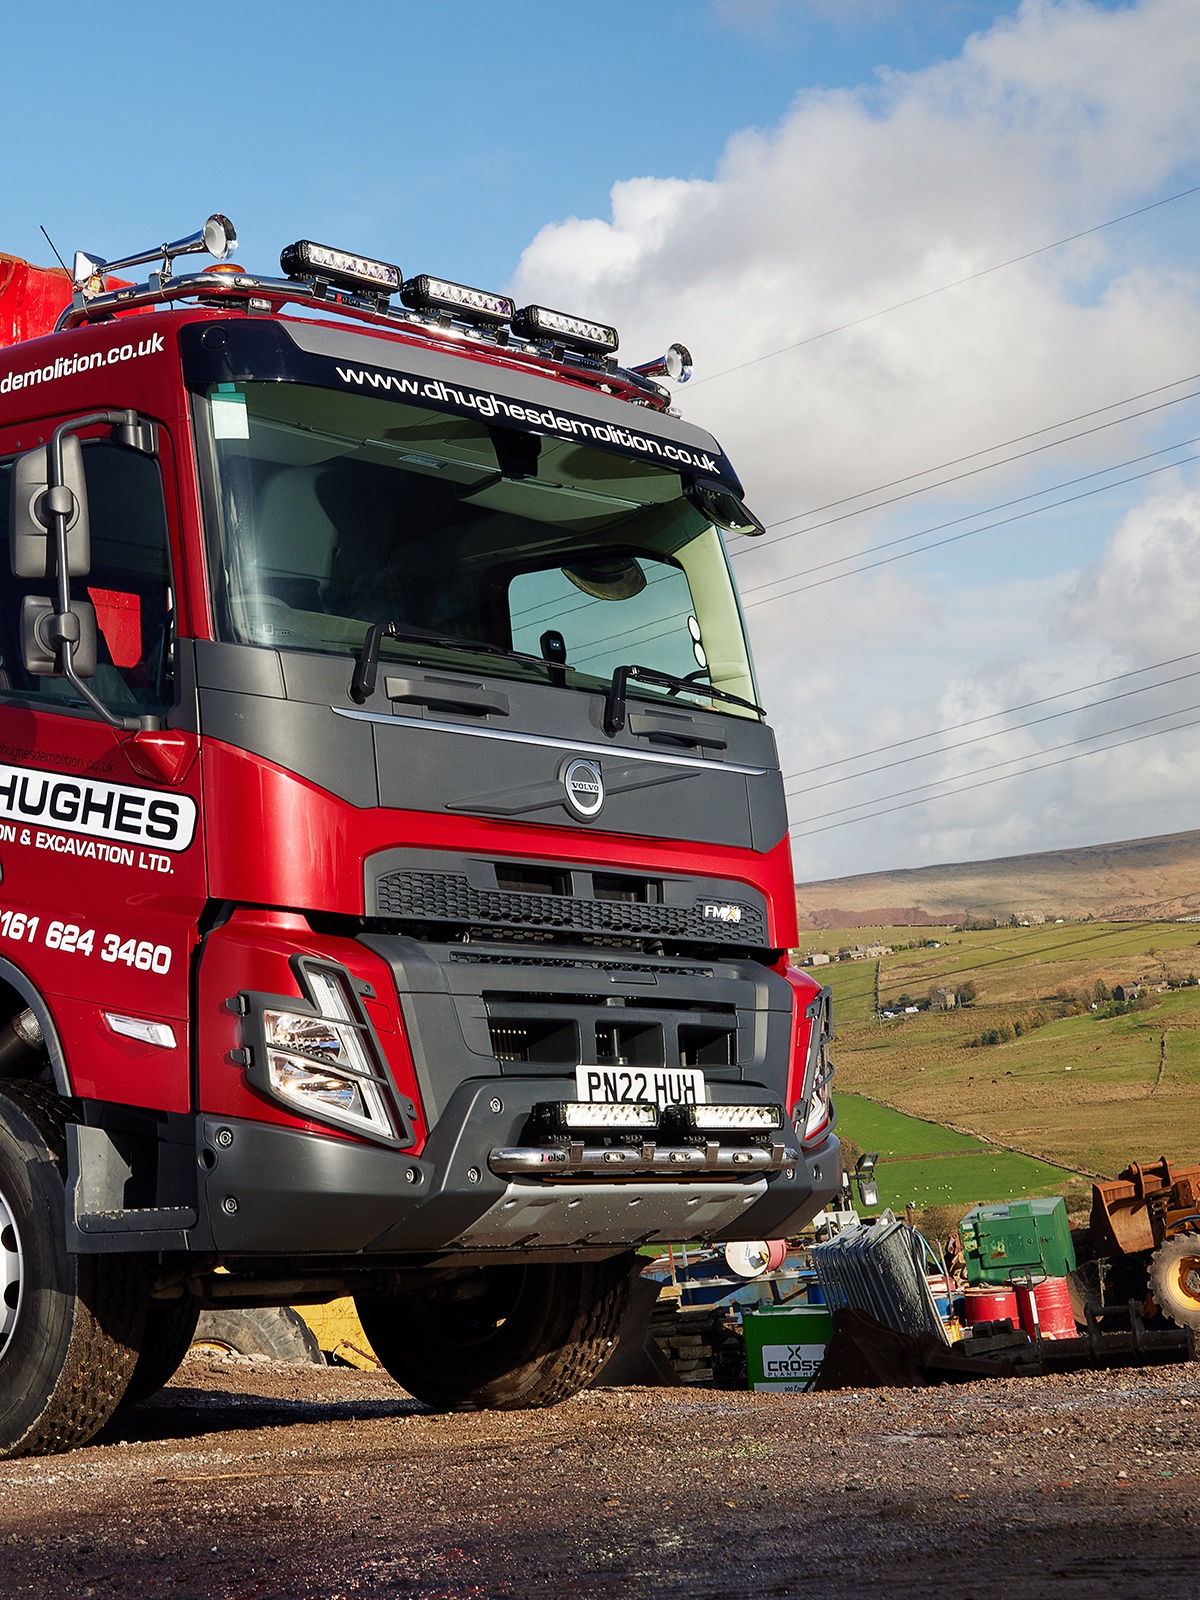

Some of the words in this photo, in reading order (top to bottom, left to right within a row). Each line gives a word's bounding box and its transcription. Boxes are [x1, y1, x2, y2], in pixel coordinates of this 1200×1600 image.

[335, 366, 721, 475] www.dhughesdemolition.co.uk
[572, 782, 599, 792] VOLVO
[20, 829, 31, 846] &
[35, 831, 134, 866] EXCAVATION
[138, 853, 175, 875] LTD.
[45, 921, 96, 957] 624
[101, 934, 172, 975] 3460
[587, 1072, 649, 1104] PN22
[654, 1074, 696, 1105] HUH
[767, 1360, 821, 1372] CROSS
